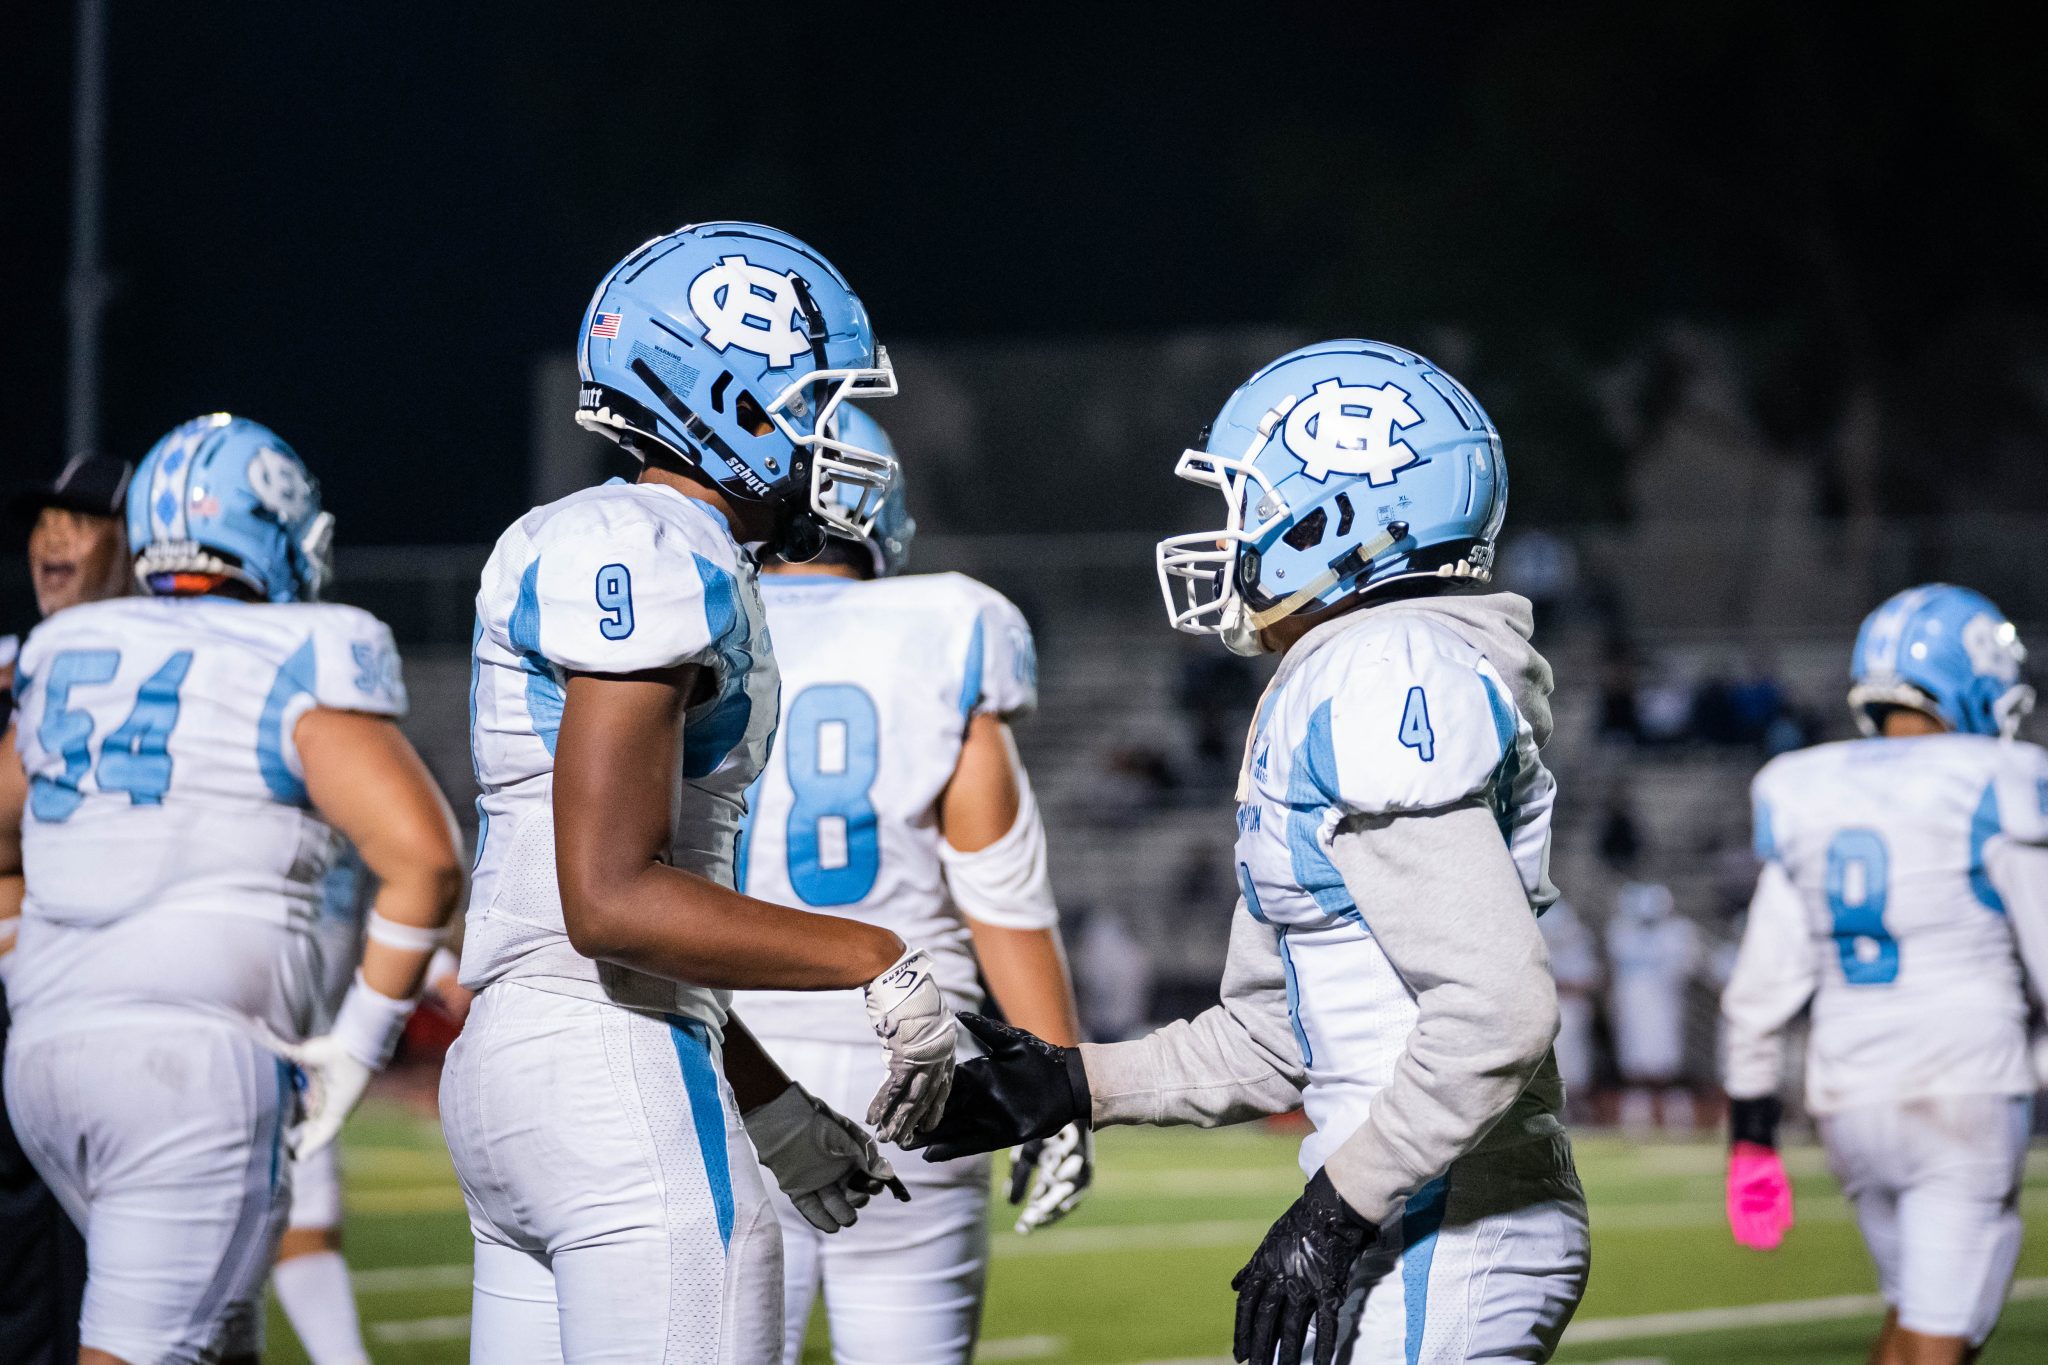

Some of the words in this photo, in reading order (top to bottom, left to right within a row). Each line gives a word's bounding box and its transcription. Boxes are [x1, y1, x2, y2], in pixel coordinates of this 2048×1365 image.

[654, 344, 682, 361] WARNING
[725, 457, 771, 497] schutt
[595, 563, 635, 641] 9
[30, 649, 194, 823] 54
[1398, 686, 1435, 762] 4
[735, 683, 881, 907] 8
[1824, 826, 1900, 985] 8
[882, 955, 919, 985] CUTTERS
